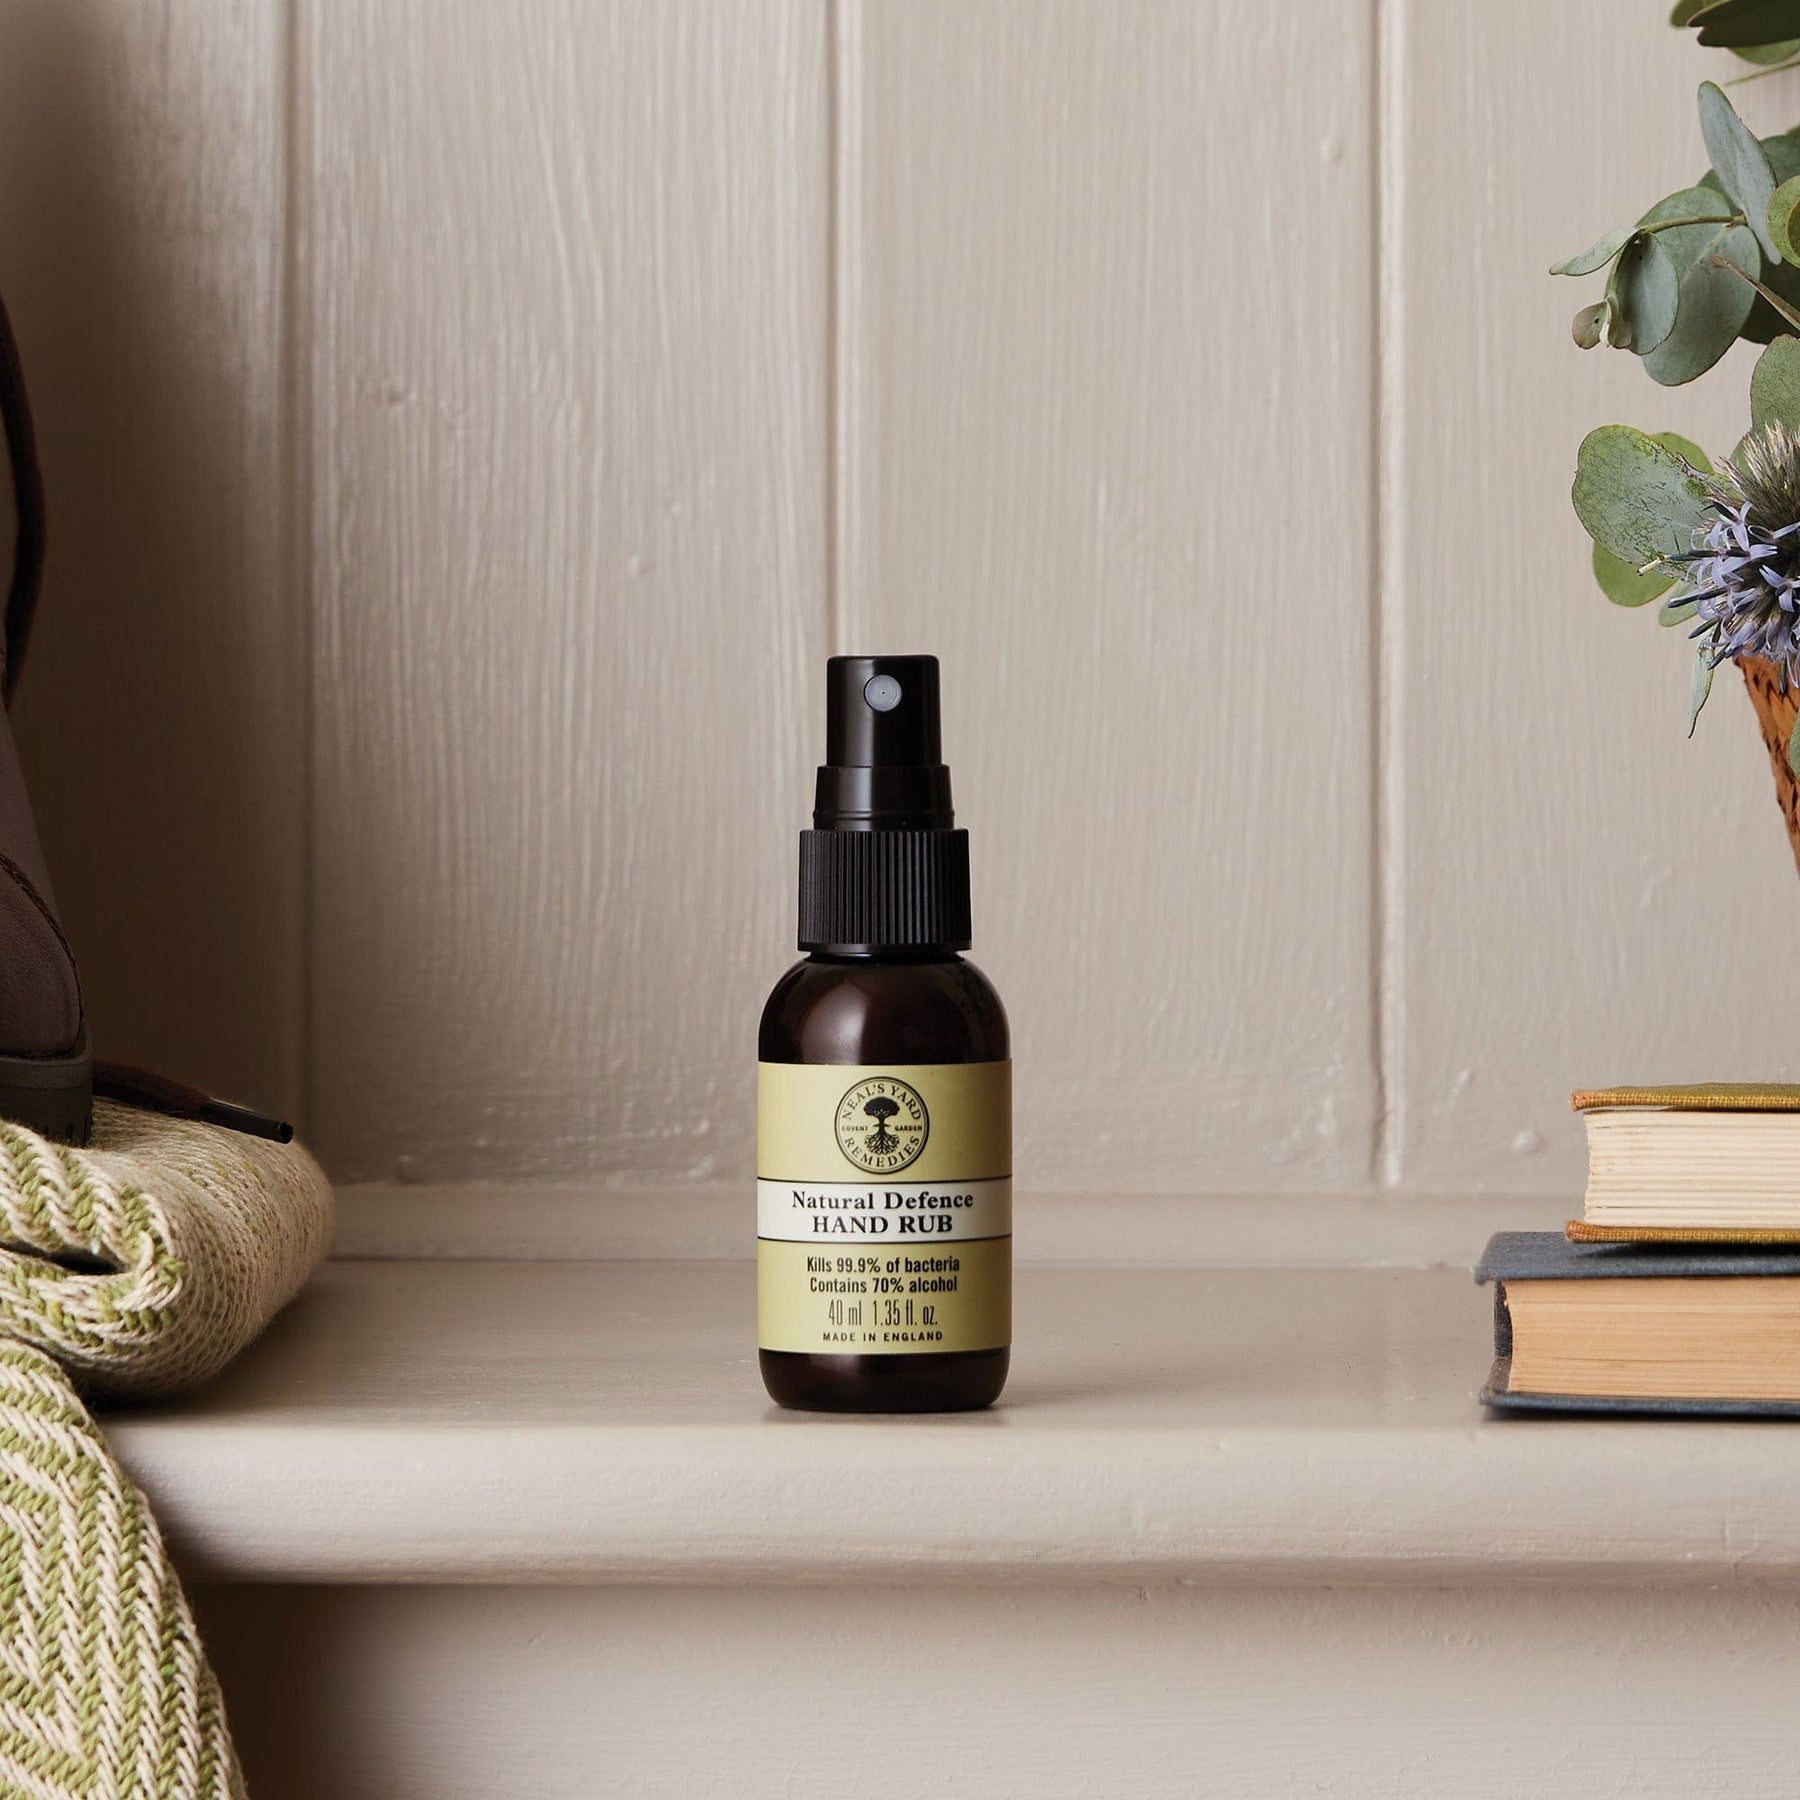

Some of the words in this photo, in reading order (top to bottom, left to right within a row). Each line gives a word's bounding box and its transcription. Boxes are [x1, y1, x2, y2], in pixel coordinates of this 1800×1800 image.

[842, 1083, 885, 1120] NEAL'S
[890, 1085, 921, 1120] YARD
[844, 1136, 920, 1167] REMEDIES
[792, 1190, 874, 1209] Natural
[884, 1191, 974, 1209] Defence
[812, 1216, 888, 1233] HAND
[899, 1215, 953, 1233] RUB
[807, 1256, 832, 1272] Kills
[837, 1258, 881, 1273] 99.9%
[886, 1257, 900, 1273] of
[905, 1256, 960, 1272] bacteria
[810, 1277, 867, 1293] Contains
[872, 1278, 904, 1293] 70%
[909, 1276, 957, 1292] alcohol
[828, 1299, 843, 1326] 40
[848, 1300, 862, 1326] ml
[872, 1299, 900, 1326] 1.35
[905, 1299, 918, 1326] fl.
[922, 1305, 938, 1326] oz.
[823, 1332, 855, 1341] MADE
[863, 1332, 876, 1341] IN
[884, 1331, 942, 1341] ENGLAND
